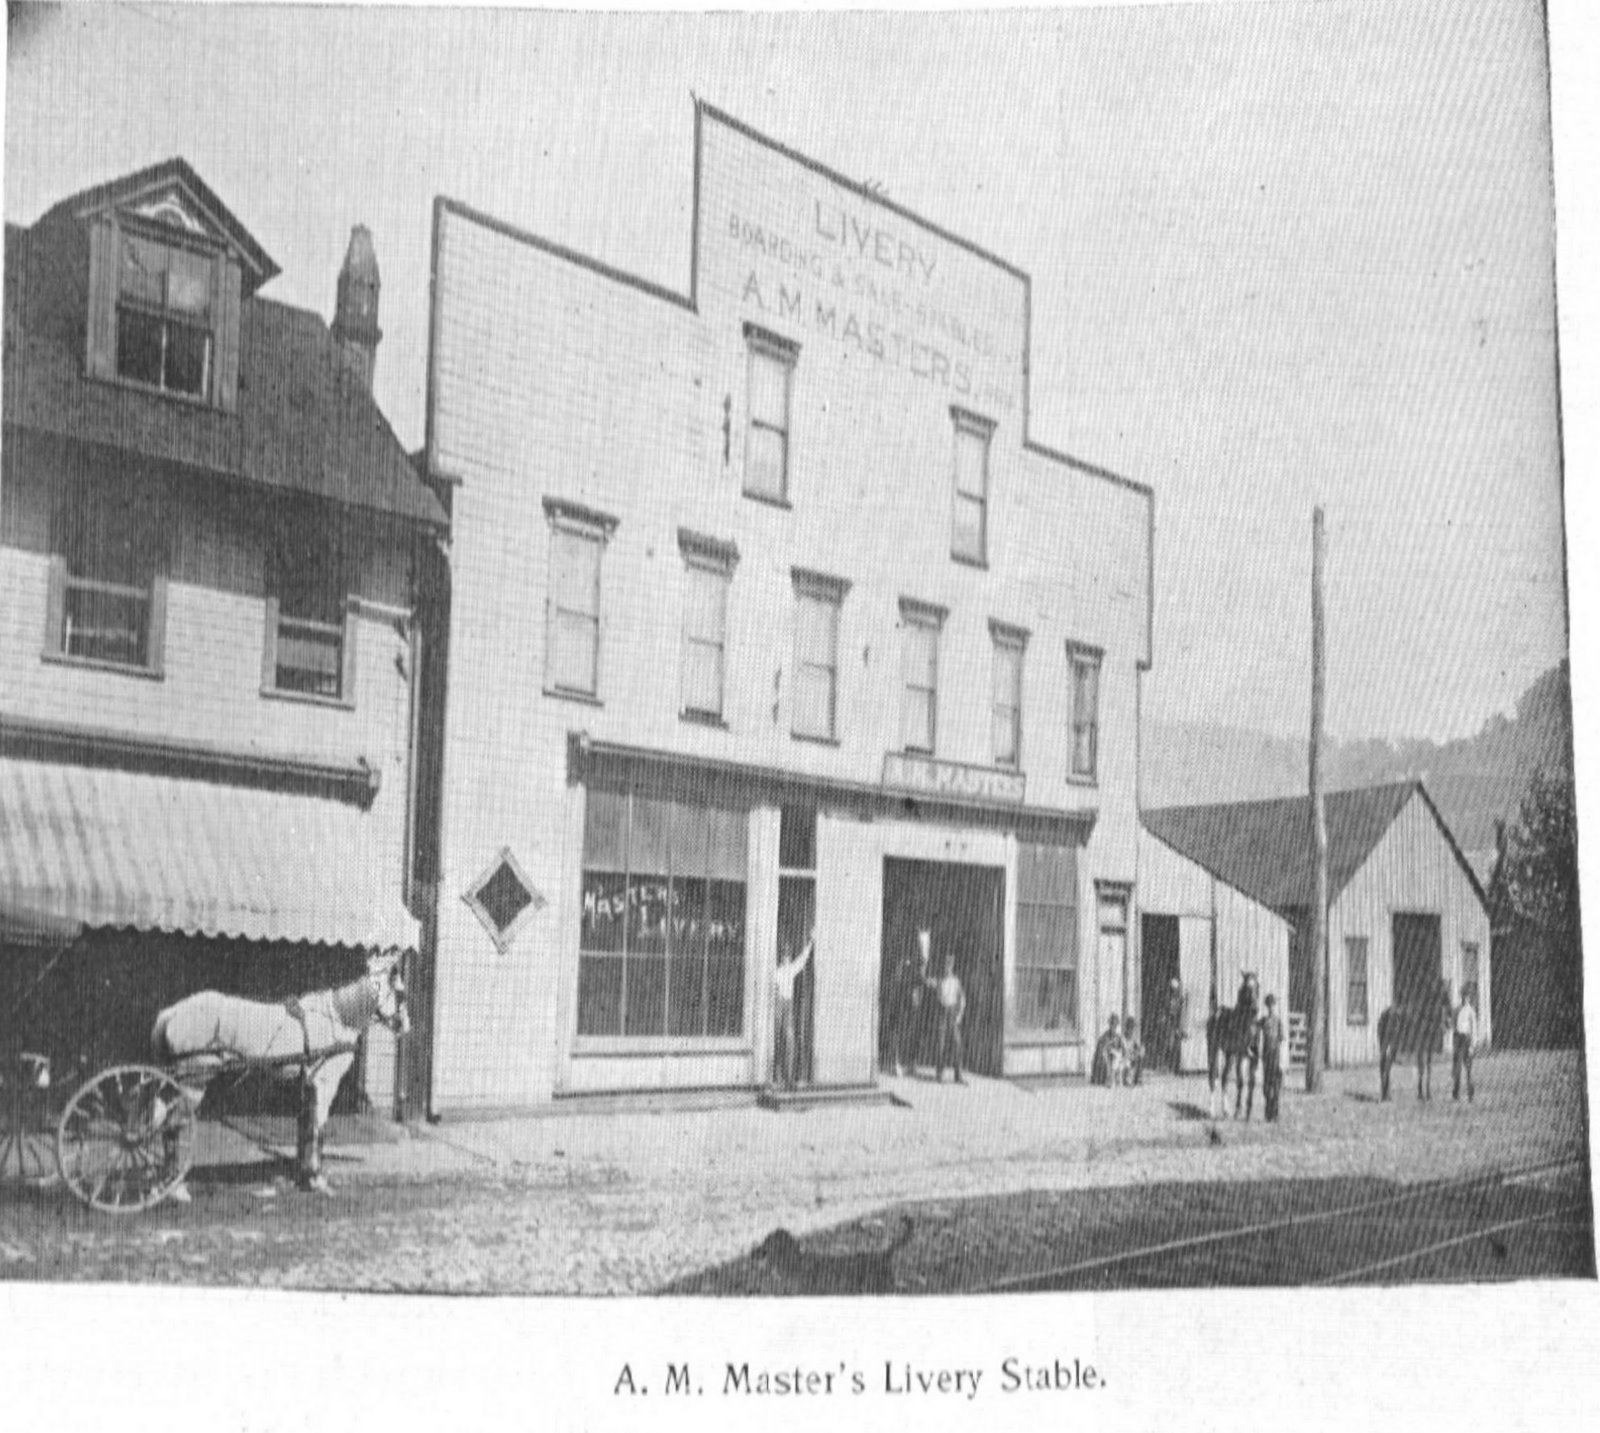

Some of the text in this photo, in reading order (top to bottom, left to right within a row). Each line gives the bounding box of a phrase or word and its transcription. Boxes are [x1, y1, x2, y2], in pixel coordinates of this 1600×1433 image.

[728, 212, 824, 279] BOARDING
[832, 262, 846, 289] &
[815, 200, 937, 281] LIVERY
